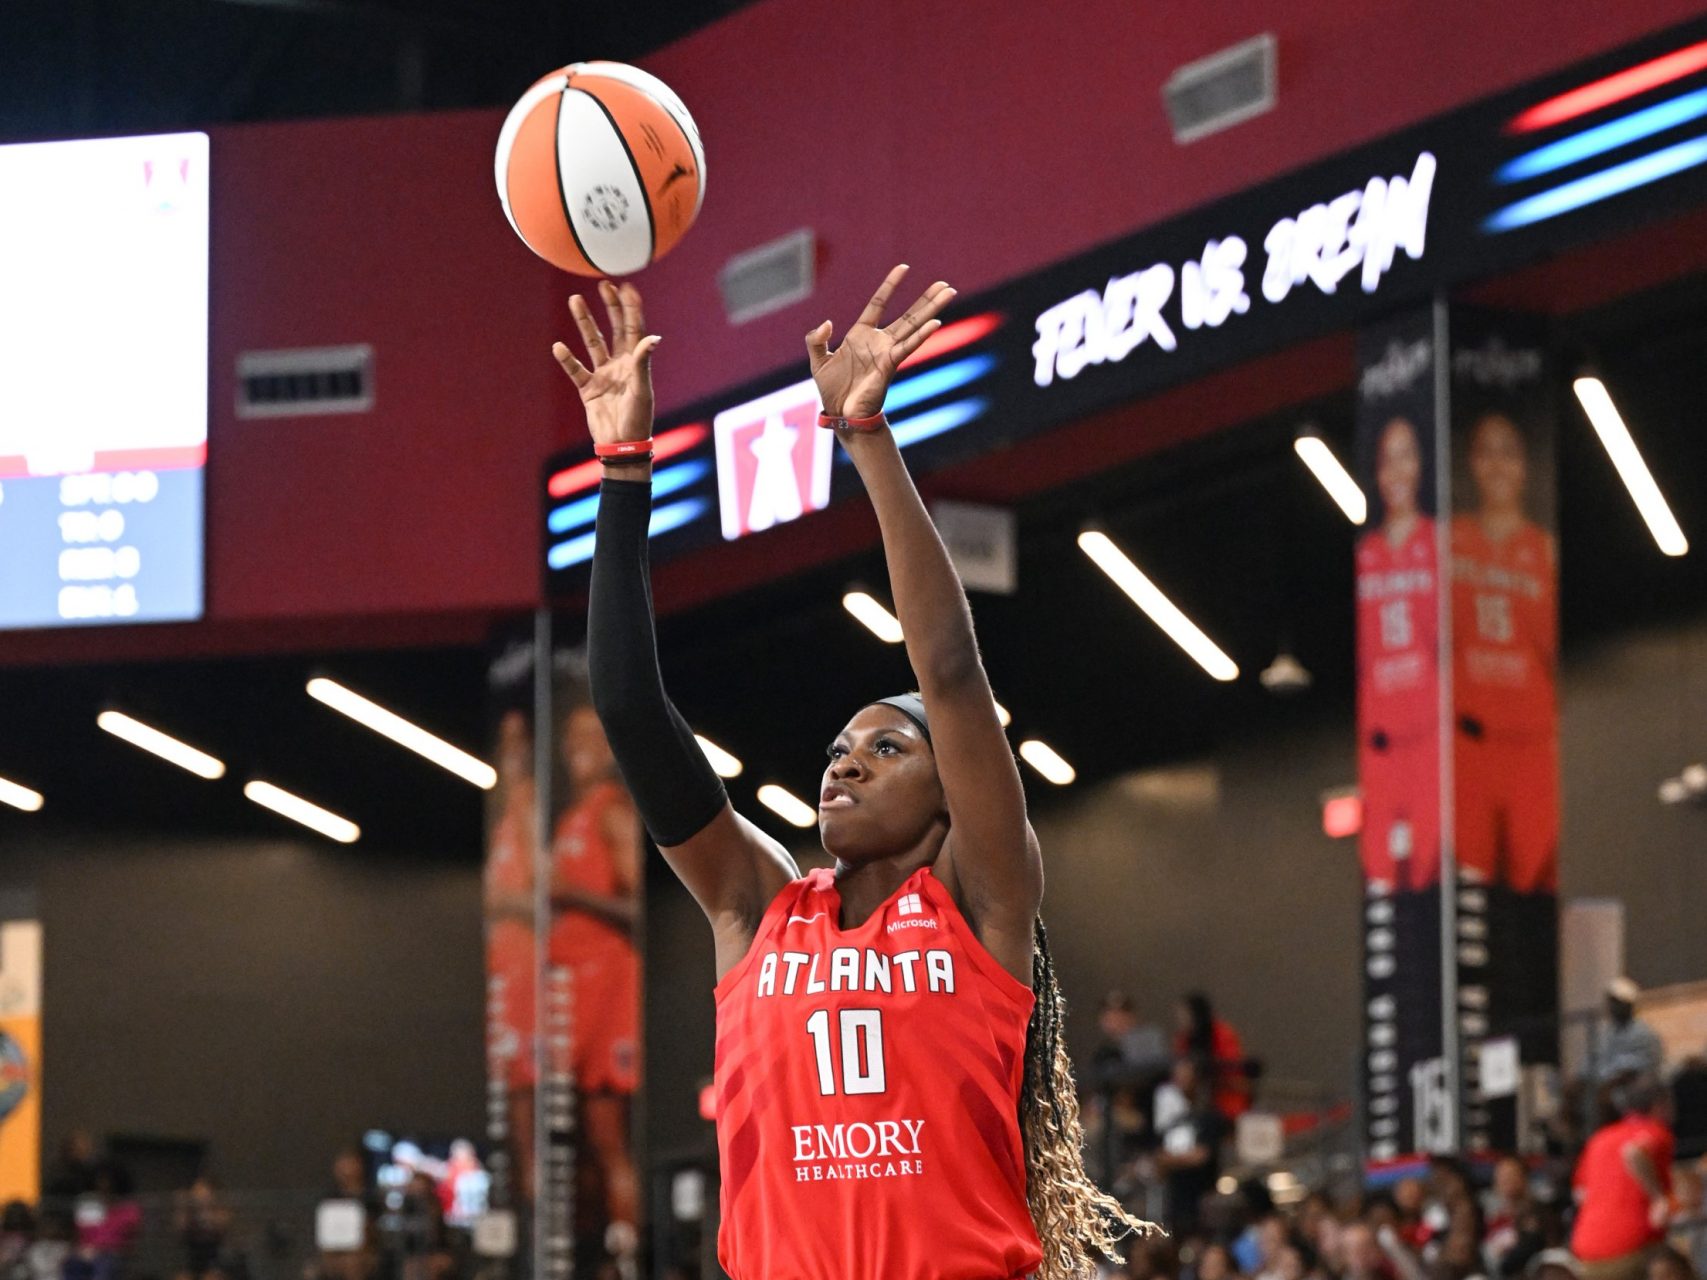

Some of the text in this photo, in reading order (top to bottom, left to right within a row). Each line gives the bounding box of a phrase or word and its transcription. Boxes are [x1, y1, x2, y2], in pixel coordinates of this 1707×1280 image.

[1032, 263, 1177, 386] FEVER
[1261, 151, 1437, 304] DREAM
[887, 918, 937, 933] Microsoft
[757, 947, 956, 998] ATLANTA
[806, 1007, 887, 1097] 10
[791, 1119, 925, 1162] EMORY
[796, 1160, 923, 1182] HEALTHCARE
